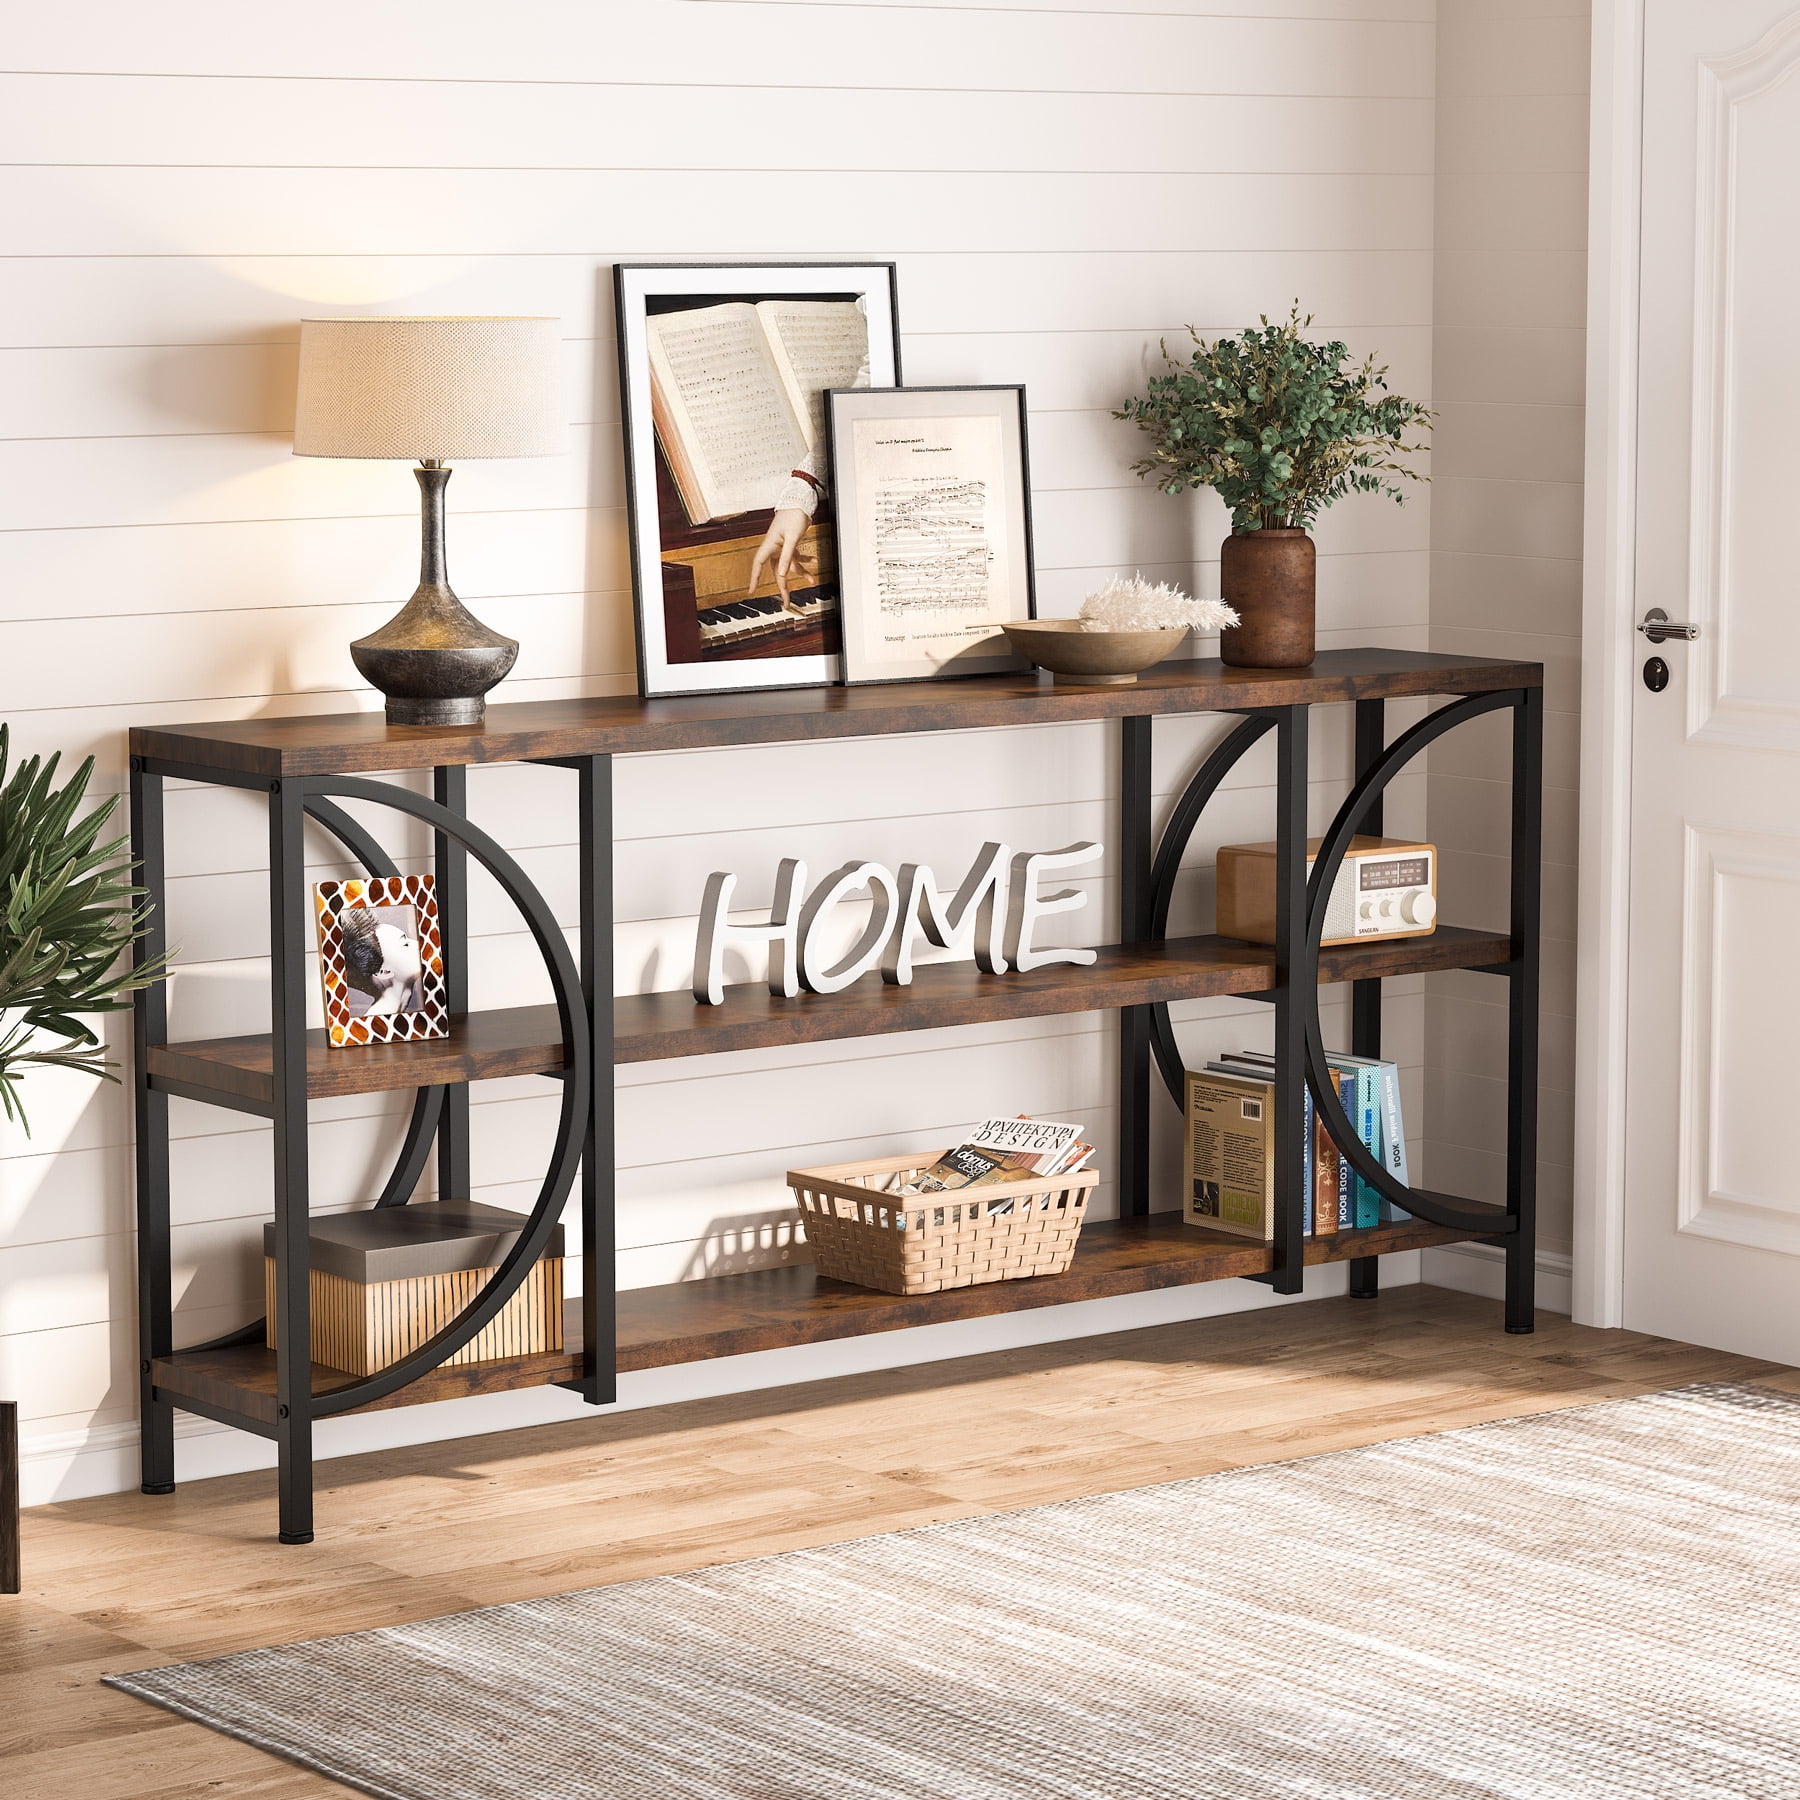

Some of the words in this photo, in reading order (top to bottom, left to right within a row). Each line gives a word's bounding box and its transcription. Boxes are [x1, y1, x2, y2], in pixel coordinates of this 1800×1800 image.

[693, 841, 1103, 1005] HOME
[976, 1130, 1066, 1149] DESIGN
[957, 1149, 994, 1170] domus
